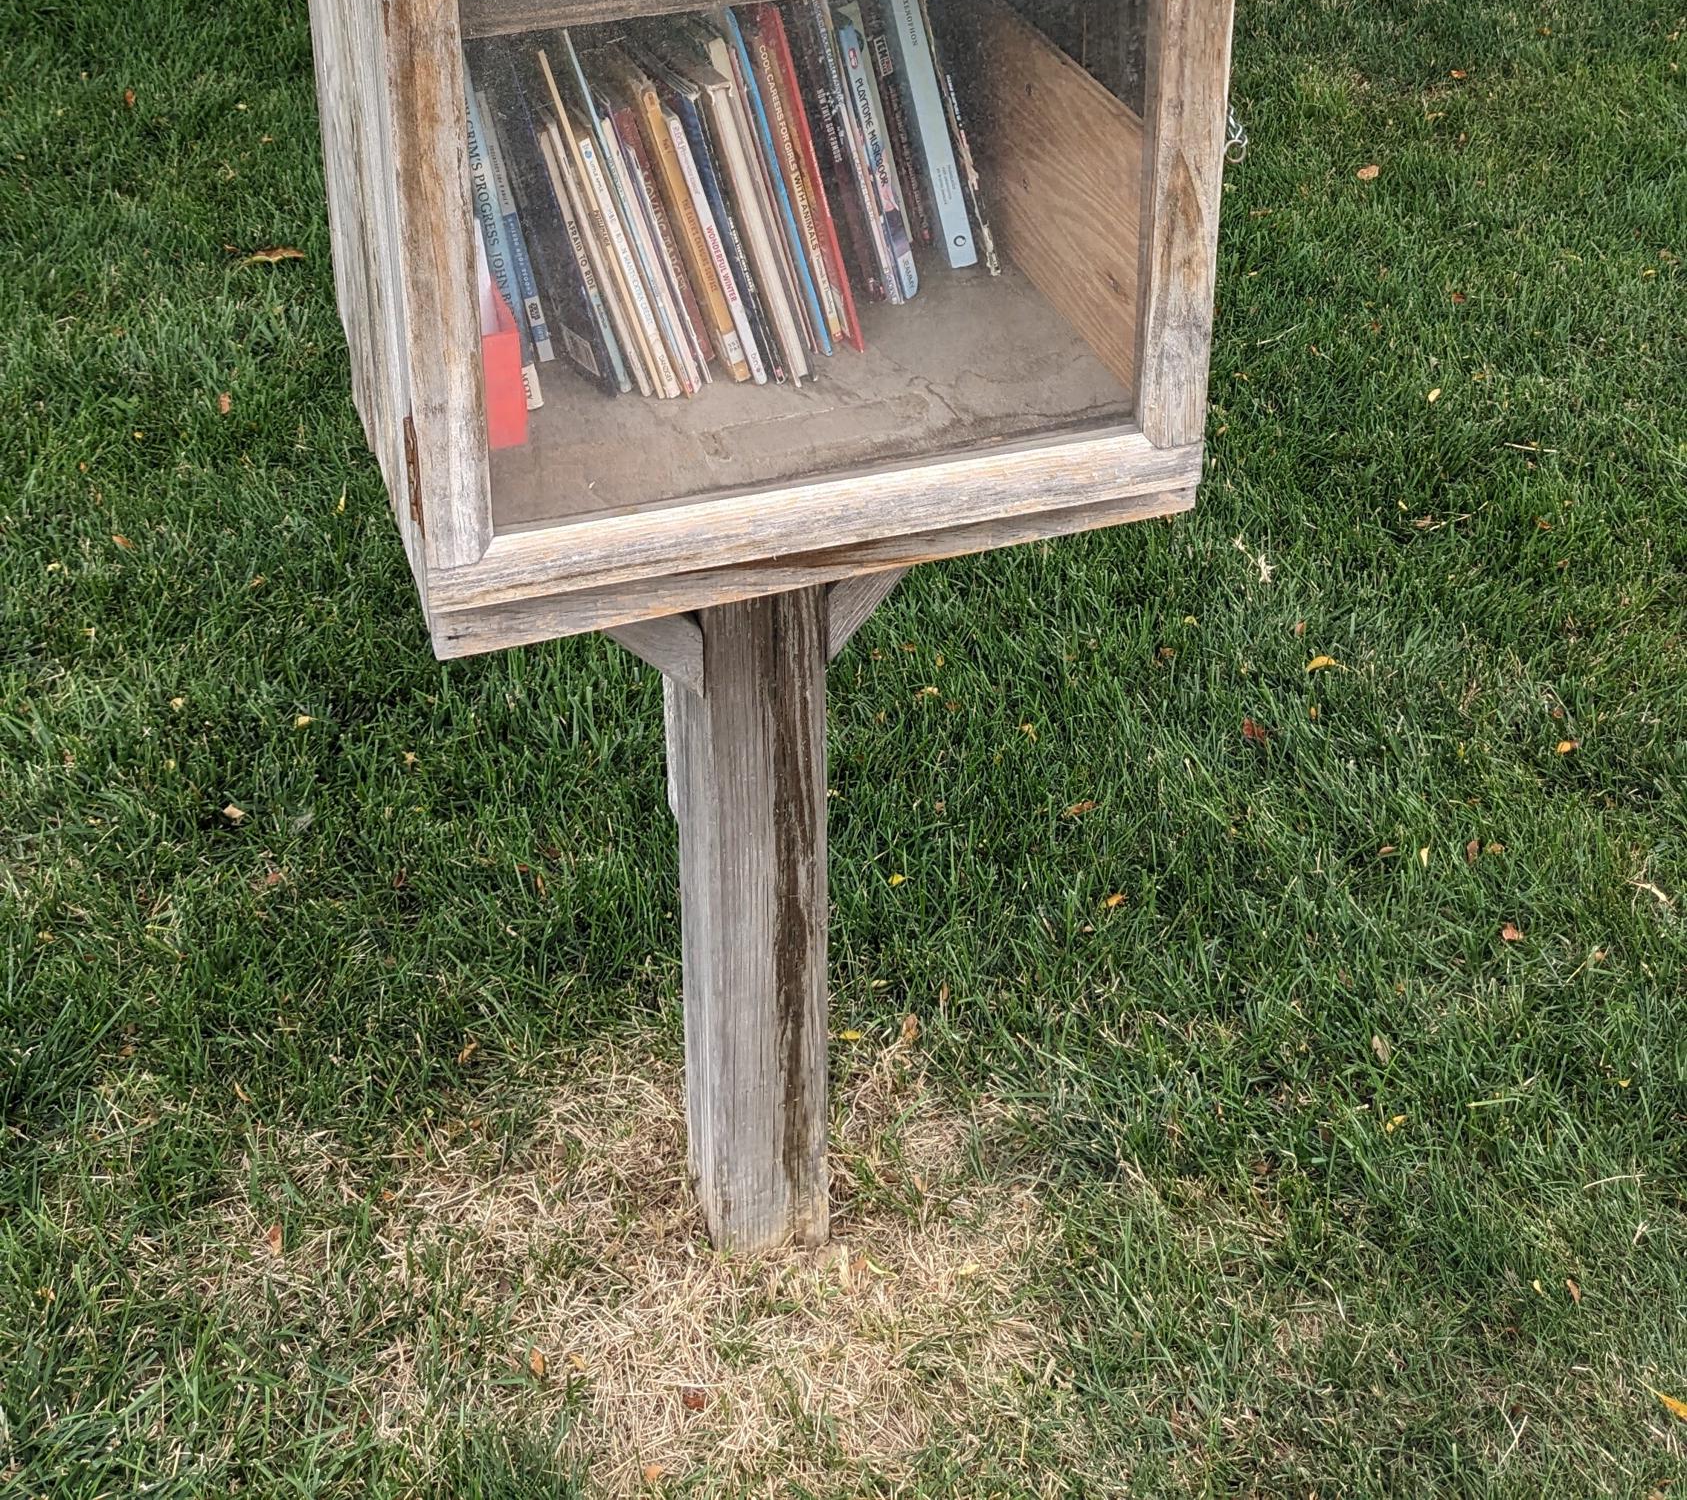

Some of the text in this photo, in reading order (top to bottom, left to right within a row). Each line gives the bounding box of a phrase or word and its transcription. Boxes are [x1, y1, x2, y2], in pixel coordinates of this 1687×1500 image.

[756, 42, 772, 75] COOL
[764, 73, 784, 121] CAREERS
[777, 120, 790, 142] FOR
[782, 142, 797, 171] GIRLS
[792, 174, 806, 202] WITH
[474, 173, 499, 248] PROGRESS
[492, 251, 511, 293] JOHN
[799, 202, 819, 251] ANIMALS
[564, 219, 583, 252] AFRAID
[576, 253, 588, 267] TO
[582, 268, 597, 291] RIDE
[705, 224, 739, 303] WONDERFUL WINTER
